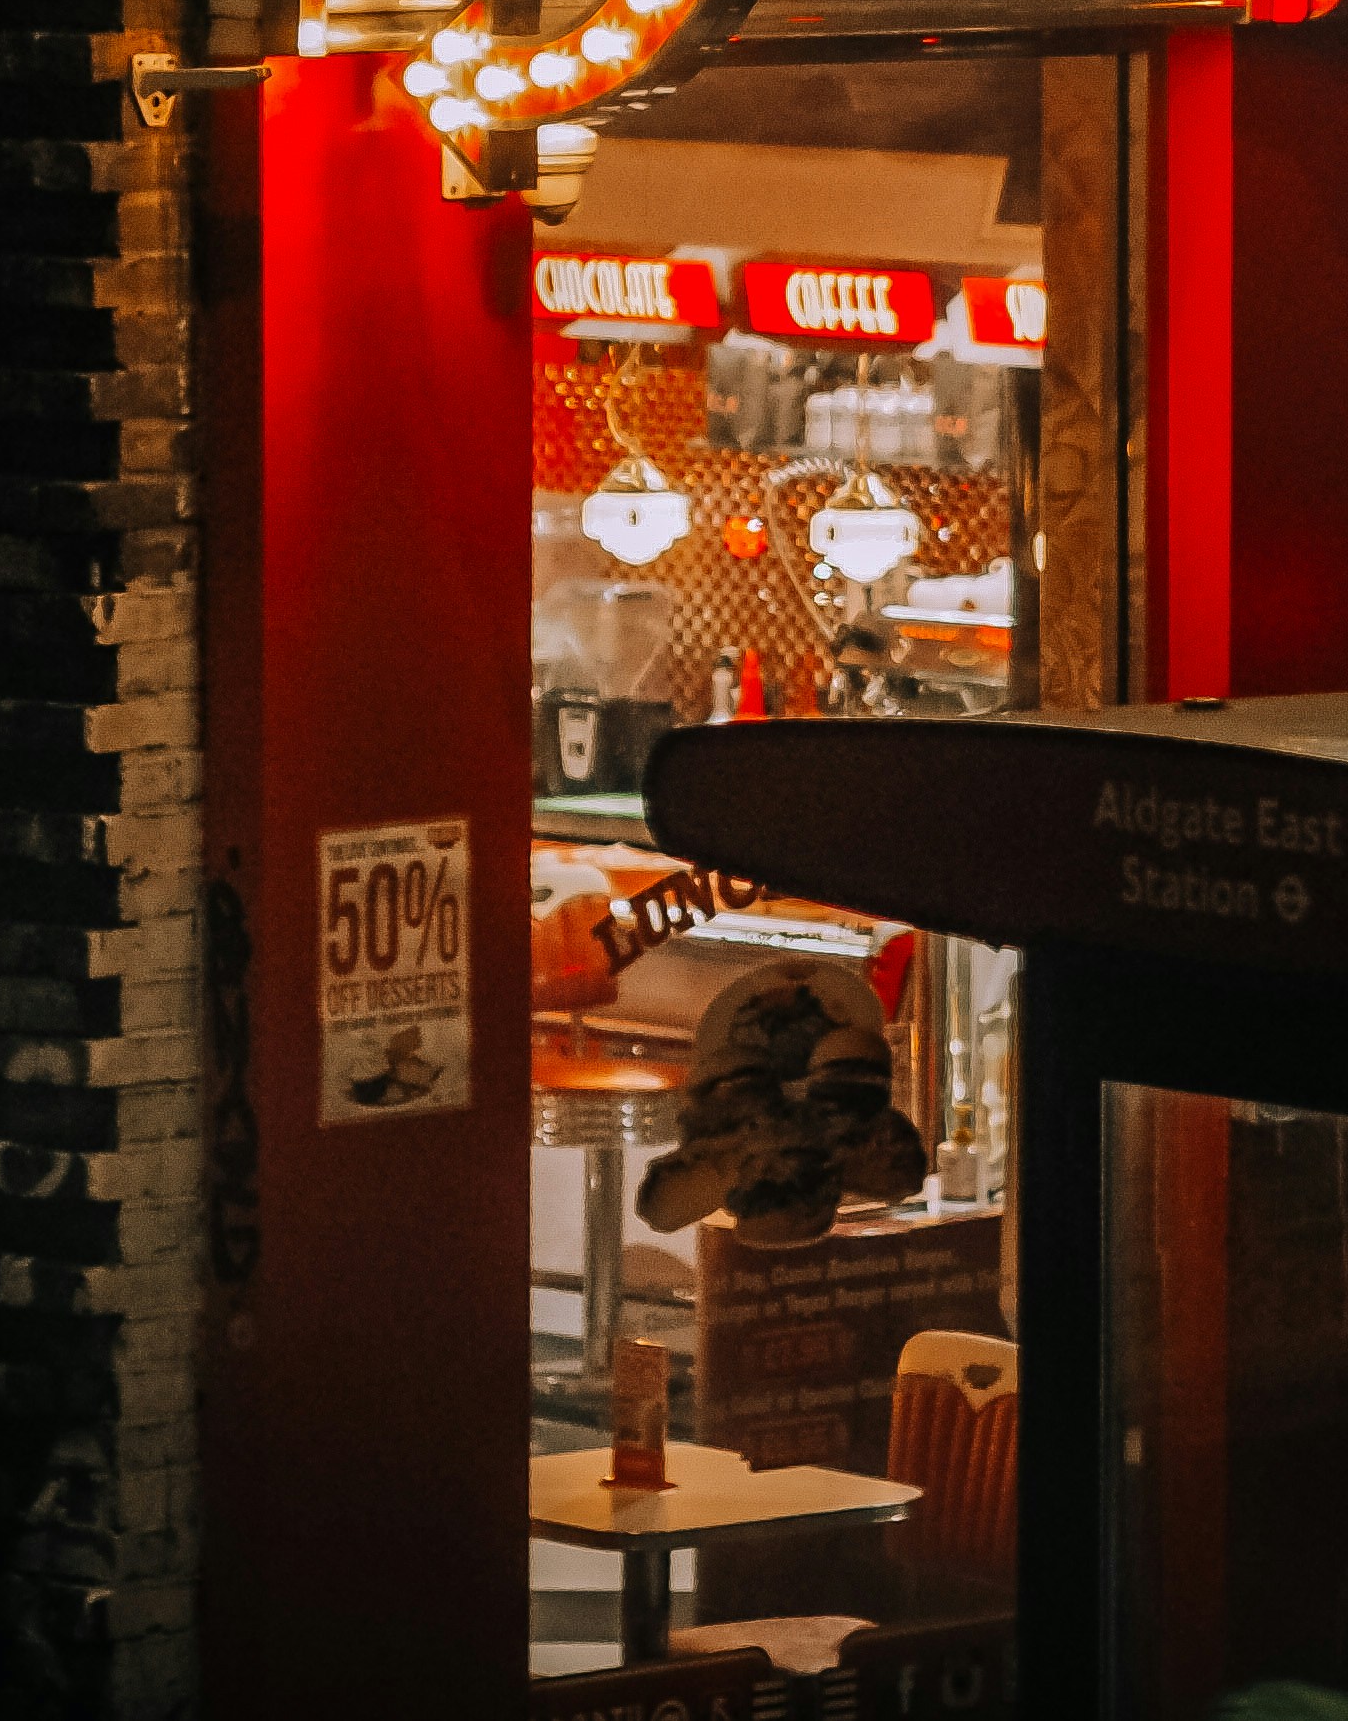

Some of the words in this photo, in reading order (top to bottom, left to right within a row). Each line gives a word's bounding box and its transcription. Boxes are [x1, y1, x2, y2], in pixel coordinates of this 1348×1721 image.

[785, 272, 899, 336] COFFEE
[1093, 780, 1246, 849] Aldgate
[1257, 796, 1344, 856] East
[327, 856, 460, 977] 50%
[593, 865, 766, 976] LUNC
[1121, 854, 1261, 918] Station
[327, 981, 363, 1017] OFF
[366, 970, 460, 1011] DESSERTS
